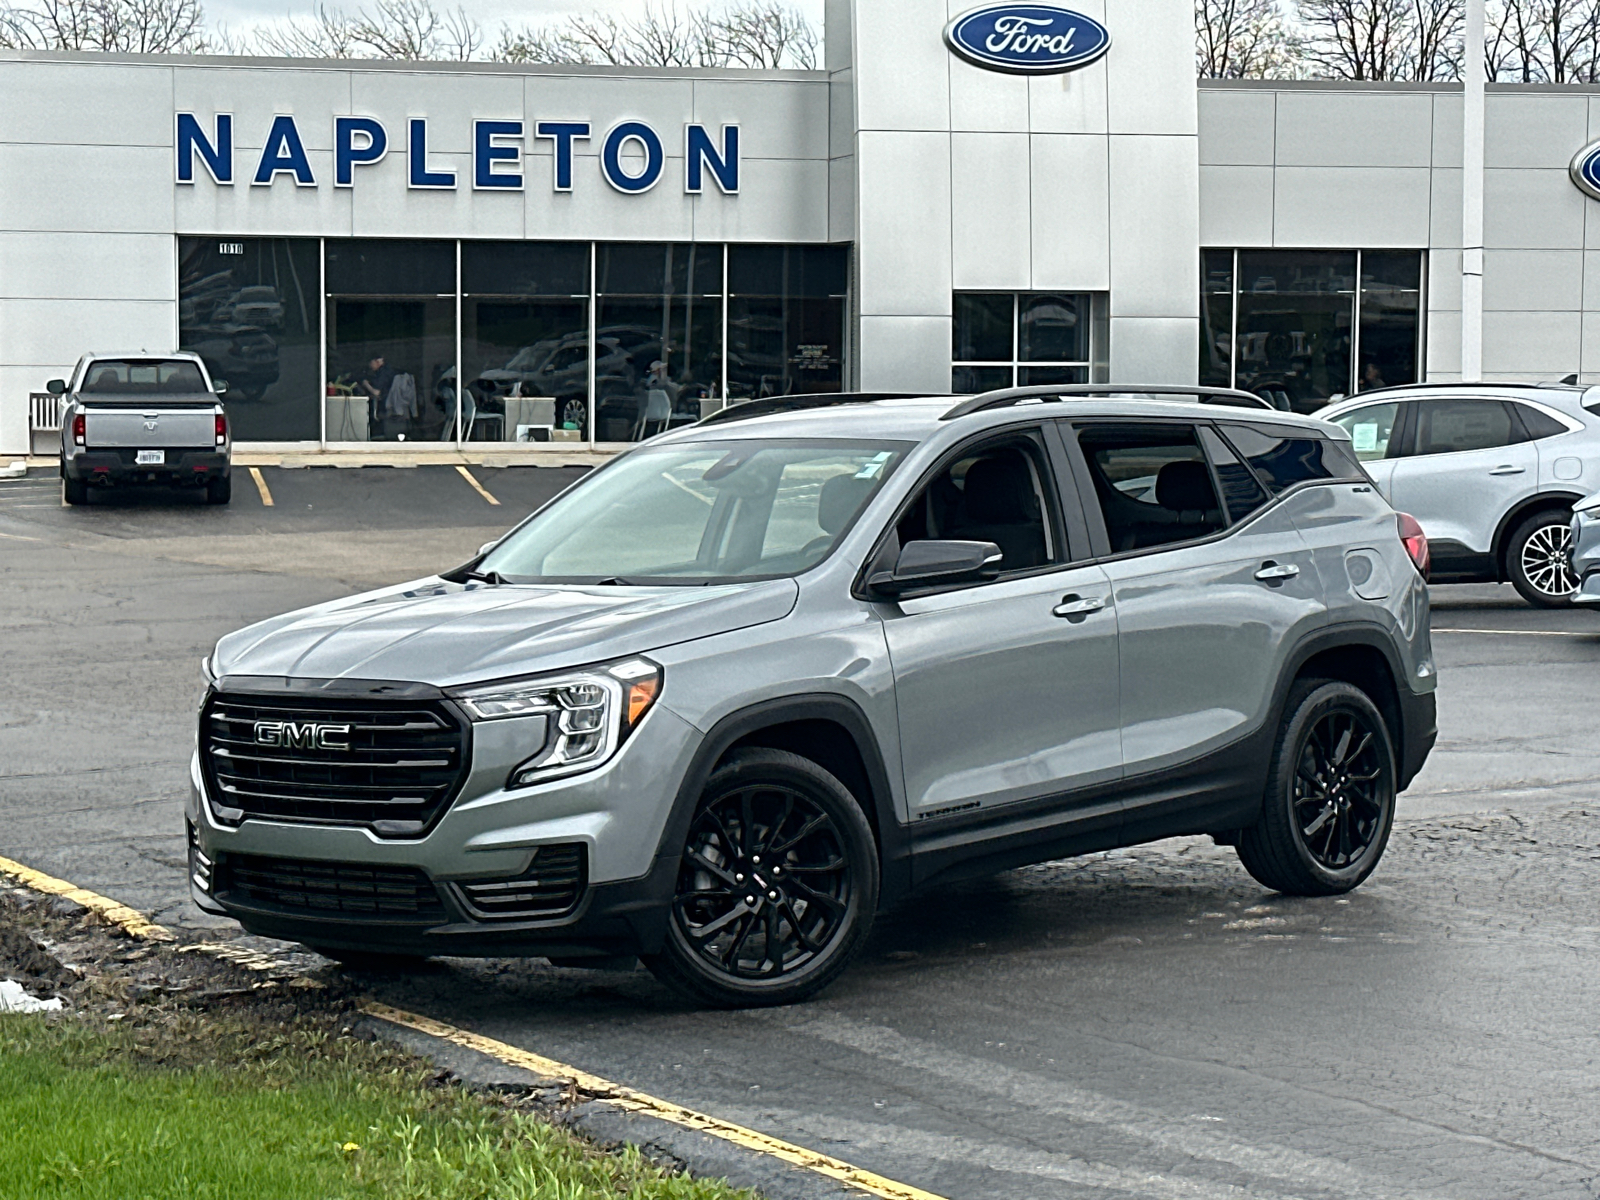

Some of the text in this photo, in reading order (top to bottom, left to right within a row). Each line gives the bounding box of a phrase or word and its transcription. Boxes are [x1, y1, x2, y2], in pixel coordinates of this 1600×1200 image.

[985, 15, 1076, 54] Ford
[174, 111, 741, 195] NAPLETON
[219, 243, 243, 254] 1010
[254, 721, 350, 750] GMC
